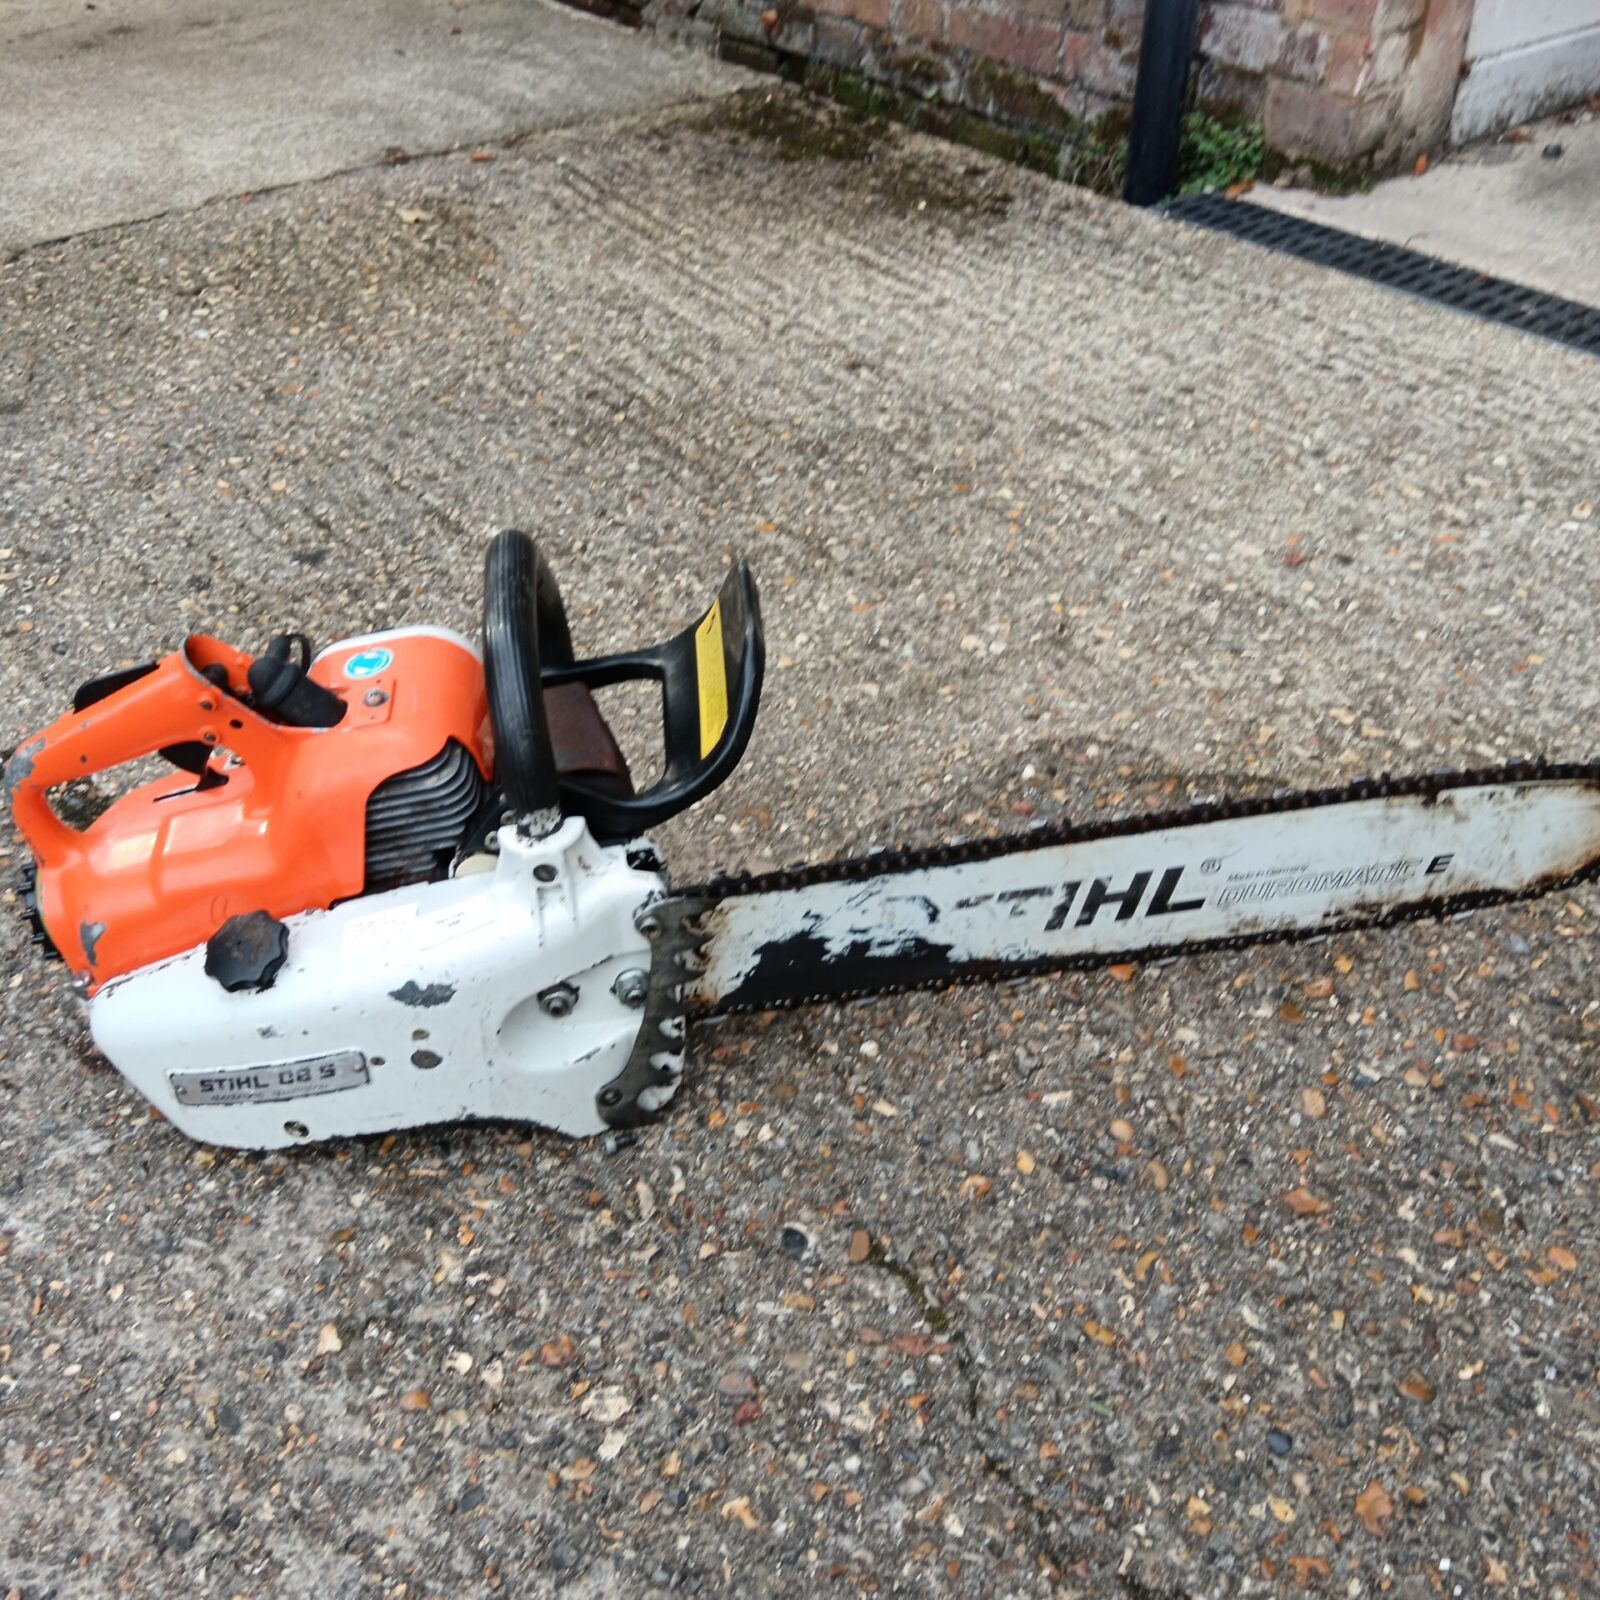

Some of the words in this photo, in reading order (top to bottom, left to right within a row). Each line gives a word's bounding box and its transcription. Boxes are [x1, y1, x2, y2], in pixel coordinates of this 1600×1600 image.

[1216, 858, 1424, 906] DUROMATIC
[1424, 853, 1455, 875] E
[199, 1076, 269, 1093] STIHL
[319, 1062, 336, 1079] S
